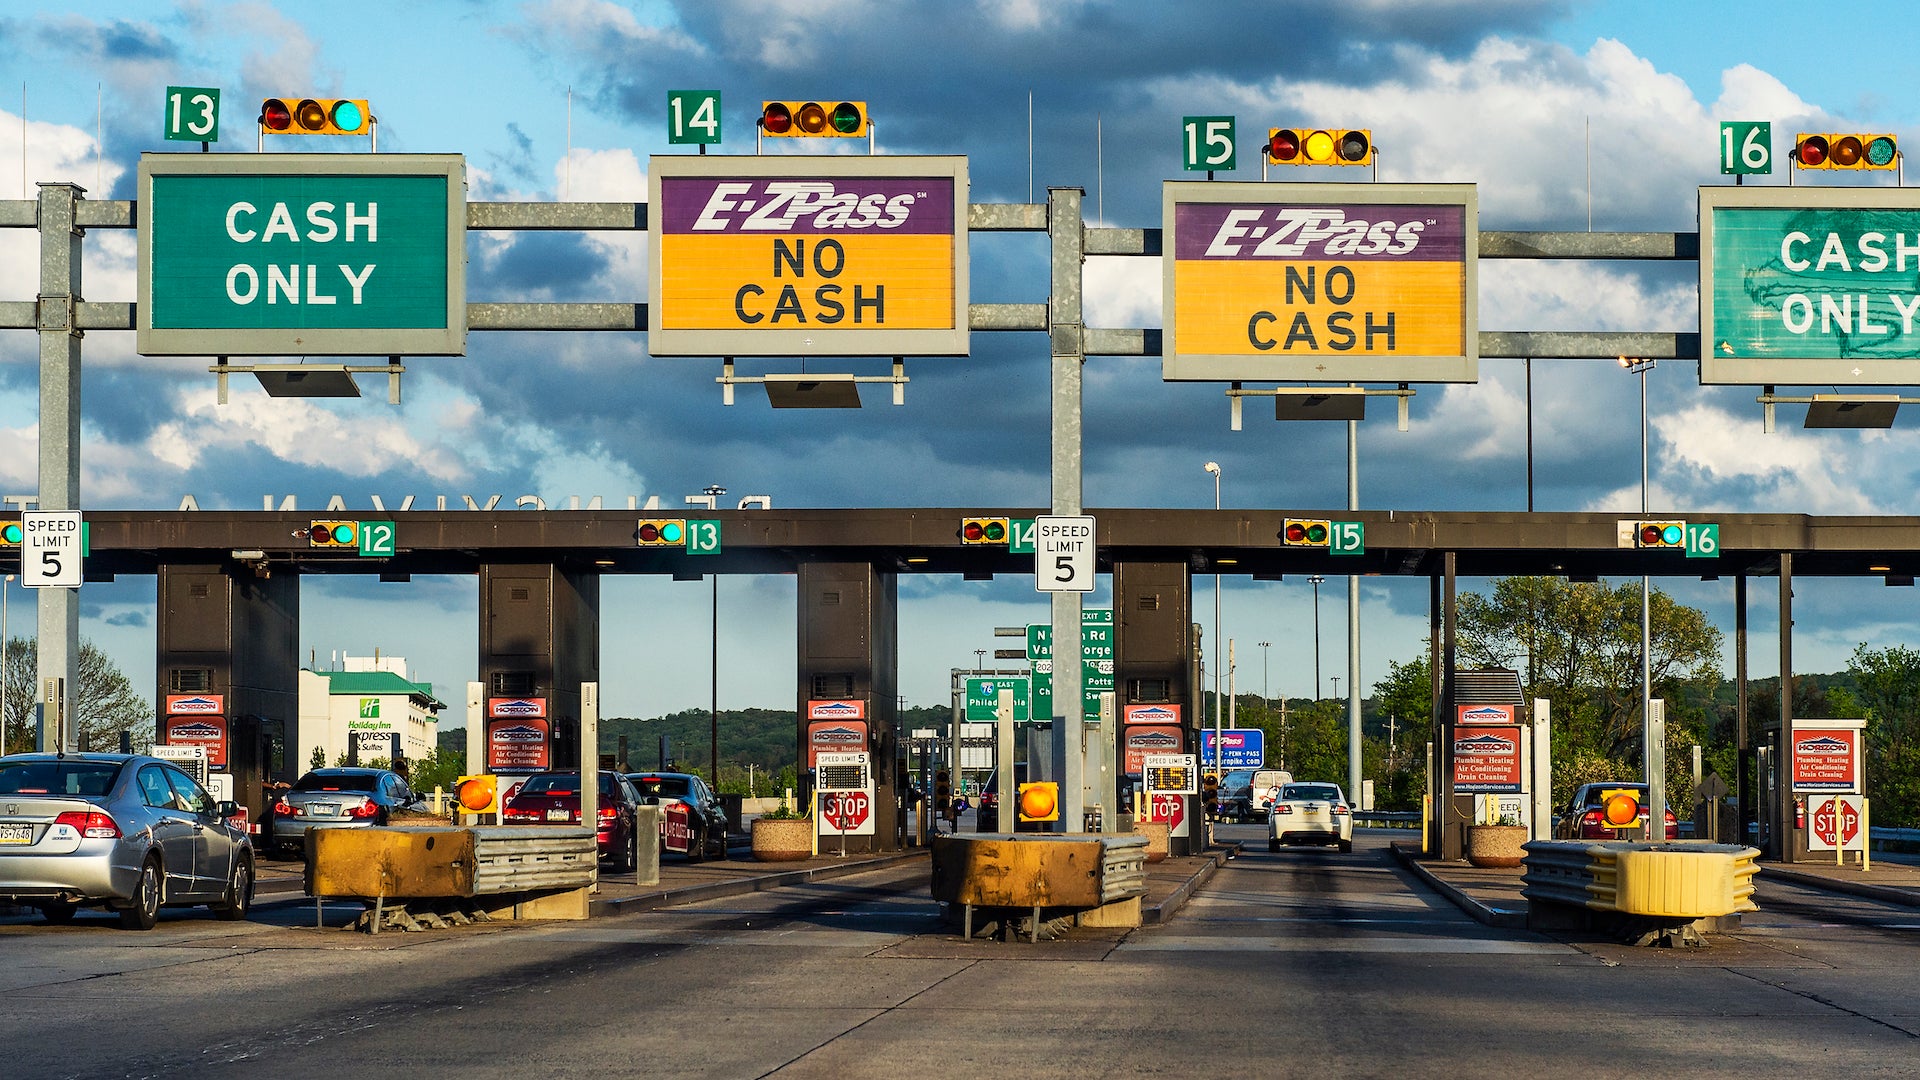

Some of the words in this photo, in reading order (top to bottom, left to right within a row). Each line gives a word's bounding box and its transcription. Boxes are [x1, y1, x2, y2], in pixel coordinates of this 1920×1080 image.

[171, 93, 214, 136] 13
[671, 97, 717, 136] 14
[1185, 122, 1233, 165] 15
[1722, 126, 1768, 169] 16
[692, 182, 915, 231] E-ZPass
[226, 202, 378, 243] CASH
[1204, 209, 1425, 256] E-ZPass
[774, 239, 845, 278] NO
[1780, 231, 1920, 273] CASH
[226, 264, 376, 305] ONLY
[1285, 266, 1355, 305] NO
[735, 284, 884, 324] CASH
[1782, 294, 1920, 334] ONLY
[1248, 311, 1396, 351] CASH
[28, 520, 76, 532] SPEED
[363, 526, 391, 551] 12
[690, 523, 717, 550] 13
[1042, 526, 1090, 537] SPEED
[1333, 524, 1361, 551] 15
[33, 536, 70, 547] LIMIT
[1047, 541, 1083, 552] LIMIT
[1689, 527, 1716, 553] 16
[42, 551, 62, 577] 5
[1055, 556, 1075, 582] 5
[1038, 631, 1046, 640] N
[1090, 631, 1106, 640] Rd
[1082, 647, 1111, 657] orge
[349, 721, 378, 730] Holiday
[379, 721, 391, 729] Inn
[195, 748, 202, 757] 5
[858, 755, 865, 763] 5
[1185, 757, 1192, 765] 5
[1489, 757, 1514, 765] Heating
[1157, 768, 1184, 789] 15
[1470, 765, 1512, 773] Conditioning
[1478, 773, 1507, 781] Cleaning
[826, 798, 867, 816] STOP
[1143, 802, 1180, 817] TOP
[1824, 832, 1848, 843] TOL
